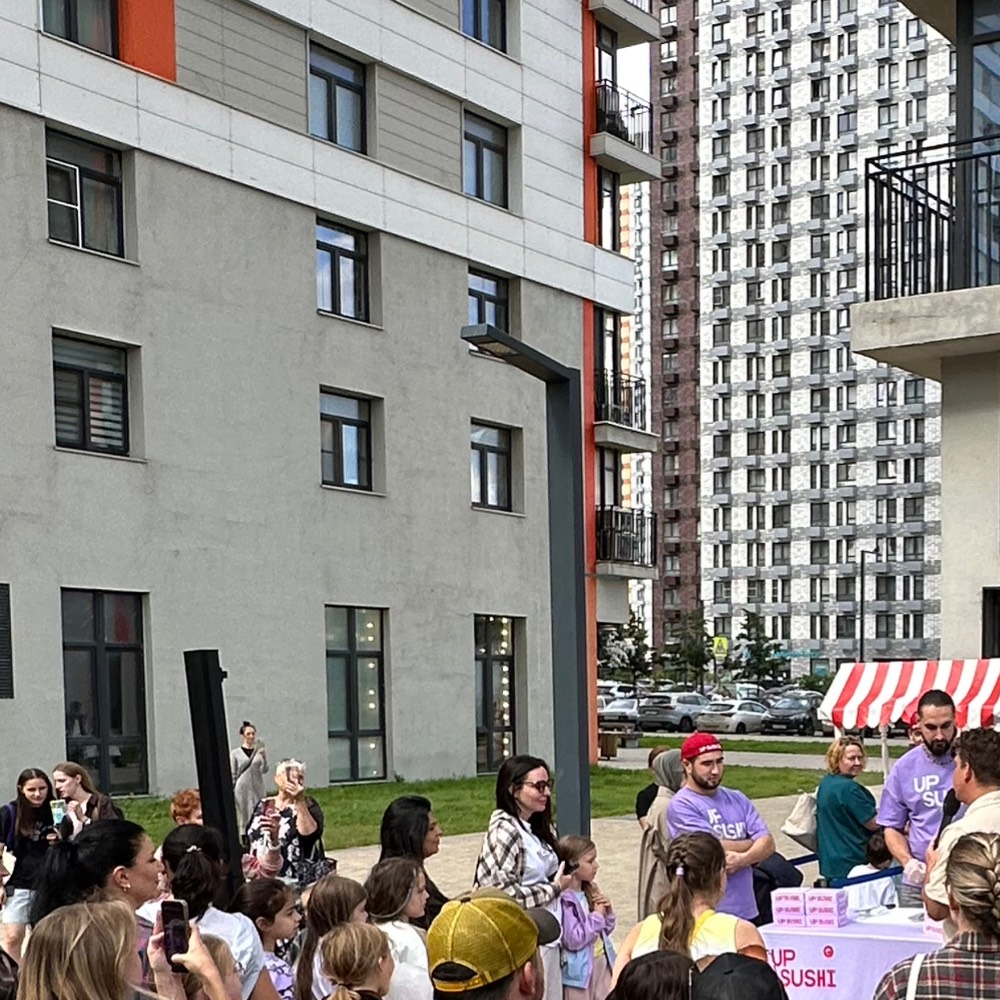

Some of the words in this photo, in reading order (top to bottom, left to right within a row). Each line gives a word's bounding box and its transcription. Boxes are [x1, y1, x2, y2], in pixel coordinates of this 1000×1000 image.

[913, 774, 940, 794] UP
[771, 949, 796, 967] UP
[781, 969, 837, 988] SUSHI
